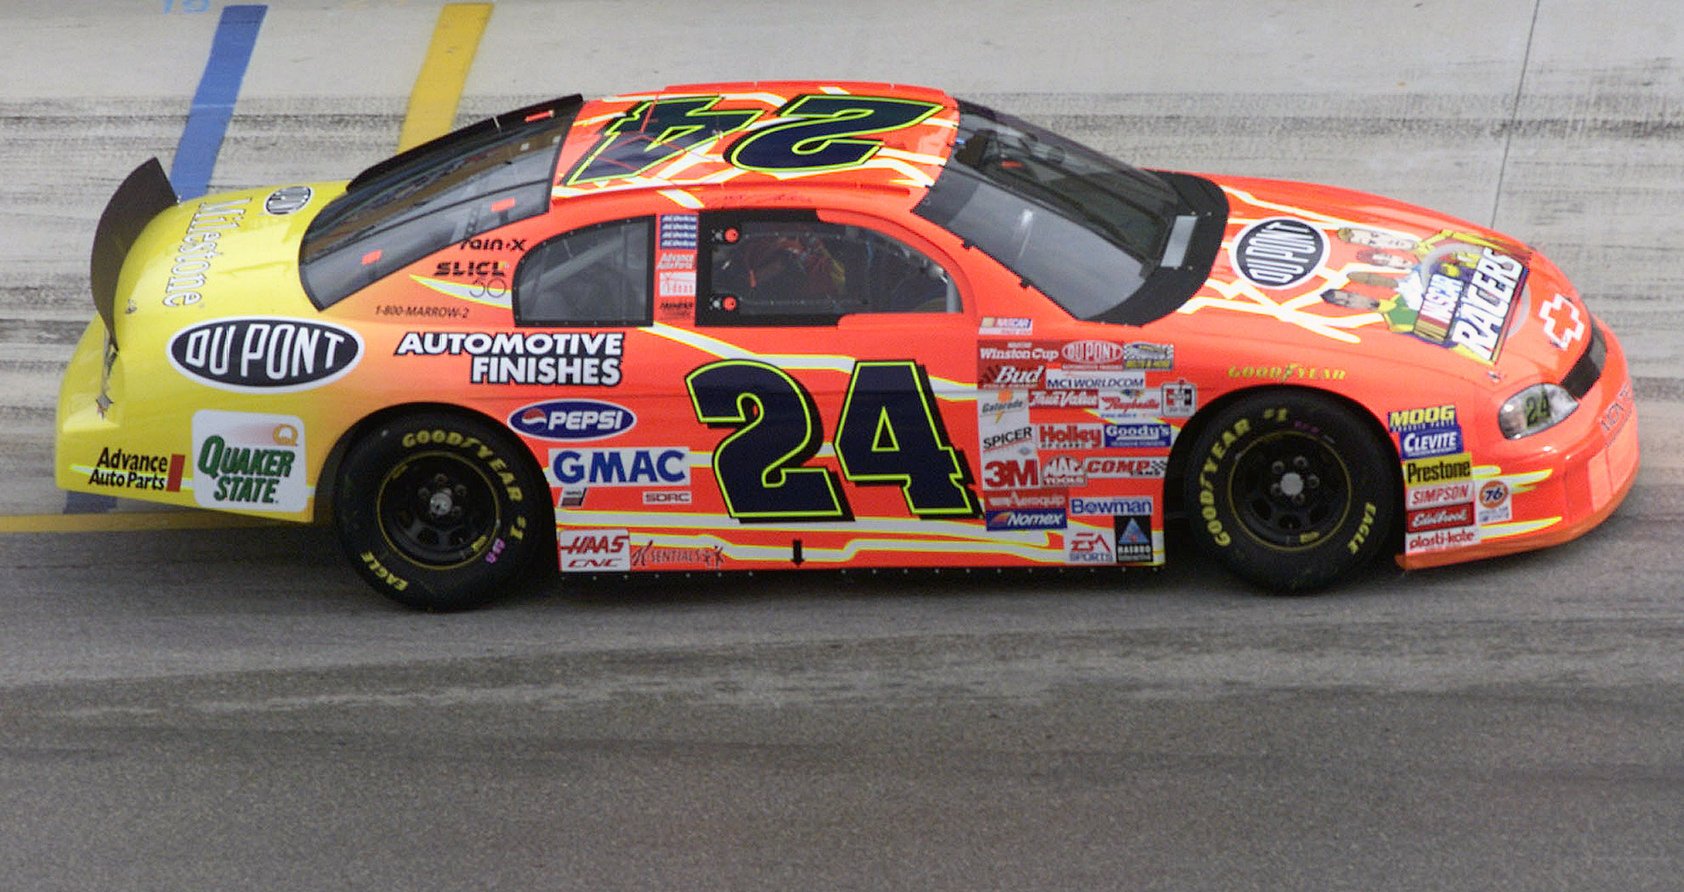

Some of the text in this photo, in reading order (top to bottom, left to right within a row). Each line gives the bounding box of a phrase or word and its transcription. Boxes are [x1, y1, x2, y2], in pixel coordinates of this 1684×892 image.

[1452, 246, 1523, 360] RACERS
[394, 332, 625, 356] AUTOMOTIVE
[980, 347, 1060, 362] Winston Cup
[470, 357, 624, 387] FINISHES
[994, 365, 1045, 384] Bud
[1074, 379, 1144, 389] WORLDCOM
[548, 410, 624, 431] PEPSI
[1389, 405, 1456, 427] MOOG
[1524, 391, 1553, 428] 24
[685, 358, 984, 523] 24
[983, 427, 1033, 450] SPICER
[1039, 425, 1102, 448] Holley
[1106, 425, 1170, 441] Goody's
[1404, 431, 1457, 453] CLEVITE
[96, 447, 168, 472] Advance
[198, 435, 295, 480] QUAKER
[553, 450, 686, 484] GMAC
[1087, 460, 1151, 473] COMP
[88, 468, 166, 490] Auto Parts
[984, 459, 1038, 487] 3M
[1407, 461, 1470, 484] Prestone
[214, 475, 278, 504] STATE
[645, 492, 691, 503] SDRC
[1412, 484, 1469, 505] SIMPSON
[1486, 487, 1503, 501] 76
[1071, 498, 1152, 514] Bowman
[1007, 511, 1063, 526] Nomex
[562, 534, 629, 555] HAAS
